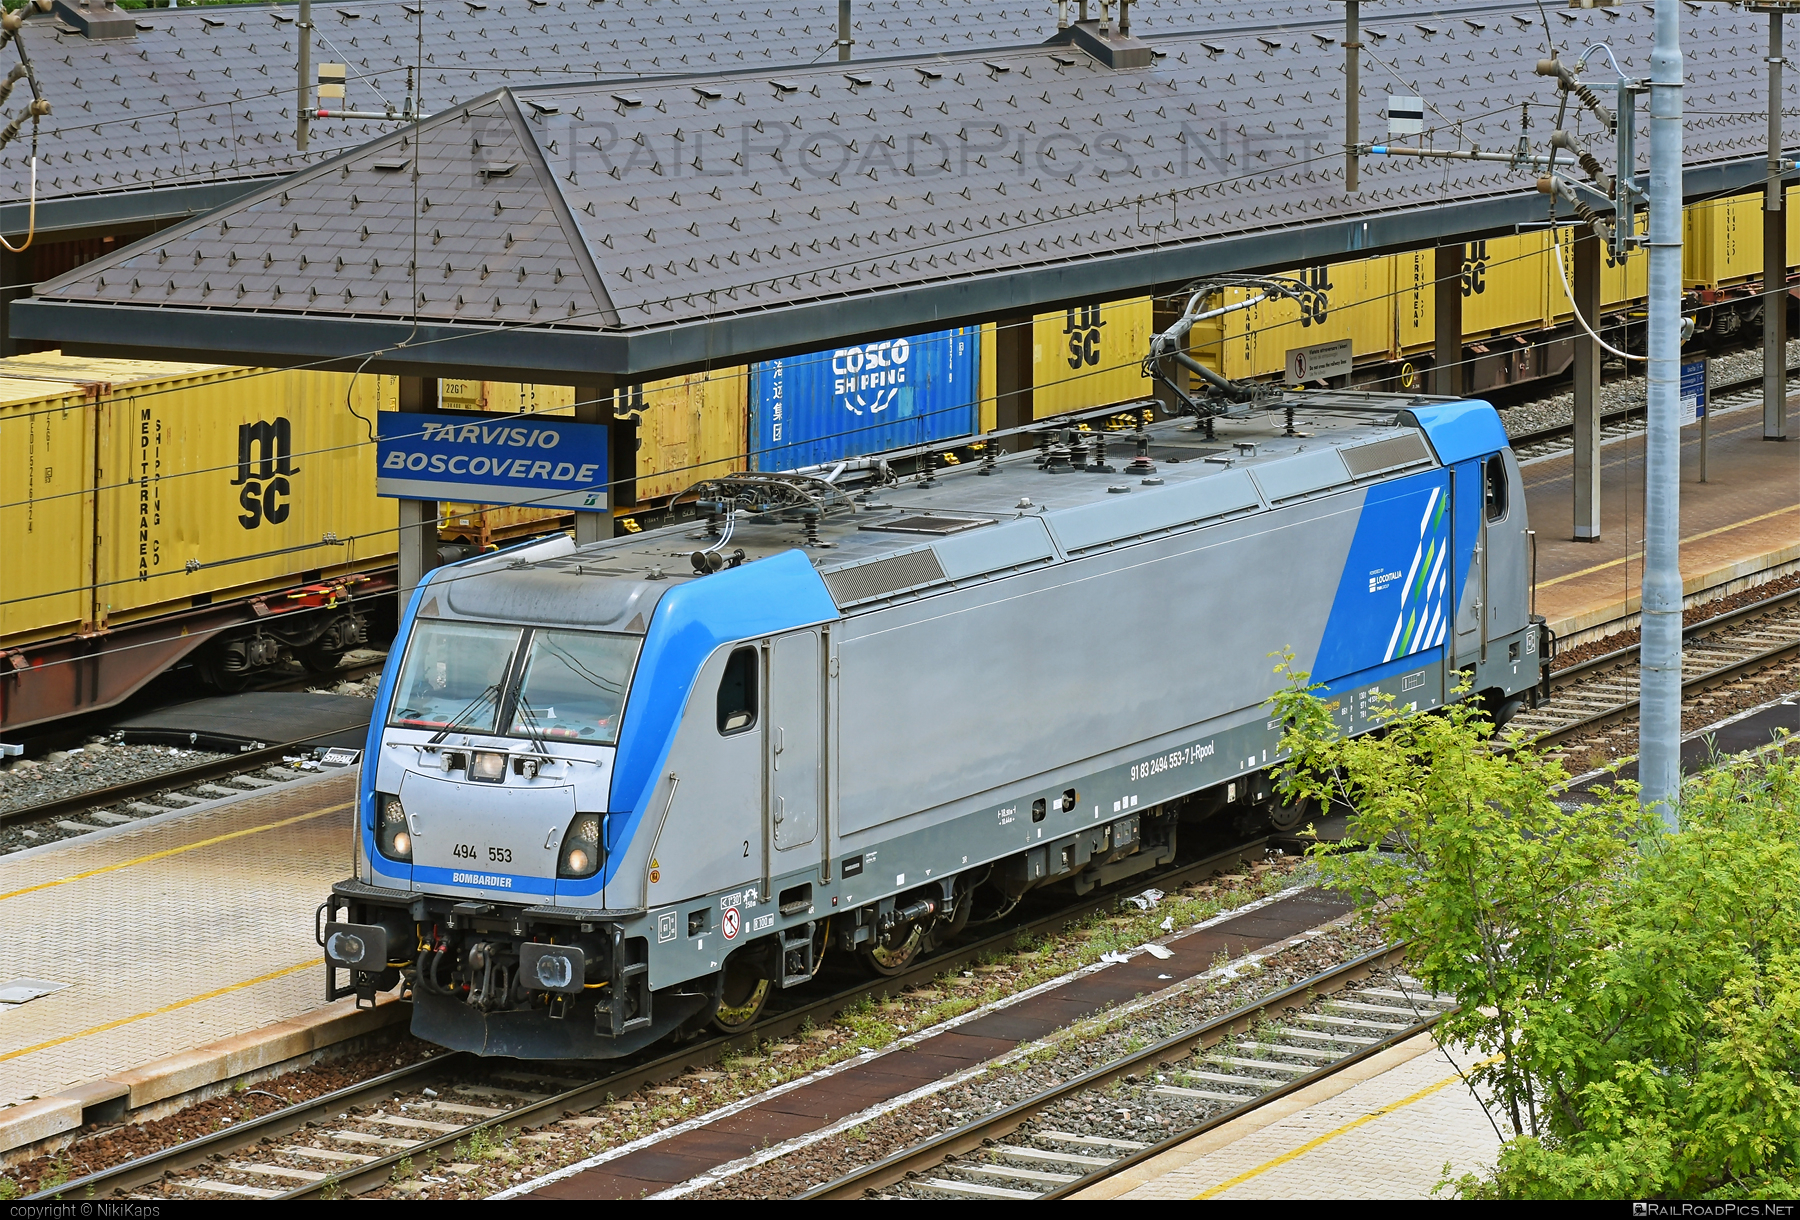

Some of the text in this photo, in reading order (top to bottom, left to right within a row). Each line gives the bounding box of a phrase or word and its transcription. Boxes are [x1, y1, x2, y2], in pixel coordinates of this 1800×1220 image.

[832, 338, 910, 375] COSCO
[1067, 328, 1101, 370] SC
[446, 383, 464, 395] 22G1
[835, 367, 906, 395] SHIPPING
[421, 422, 560, 449] TARVISIO
[382, 450, 600, 483] BOSCOVERDE
[139, 408, 151, 582] MEDITERRANEAN
[1376, 570, 1402, 584] LOCOITALIA
[1130, 764, 1139, 781] 91
[1140, 761, 1149, 778] 83
[1150, 755, 1168, 776] 2494
[1169, 748, 1190, 769] 553-7
[453, 843, 513, 863] 494 553
[743, 840, 749, 858] 2
[452, 872, 513, 888] BOMBARDIER
